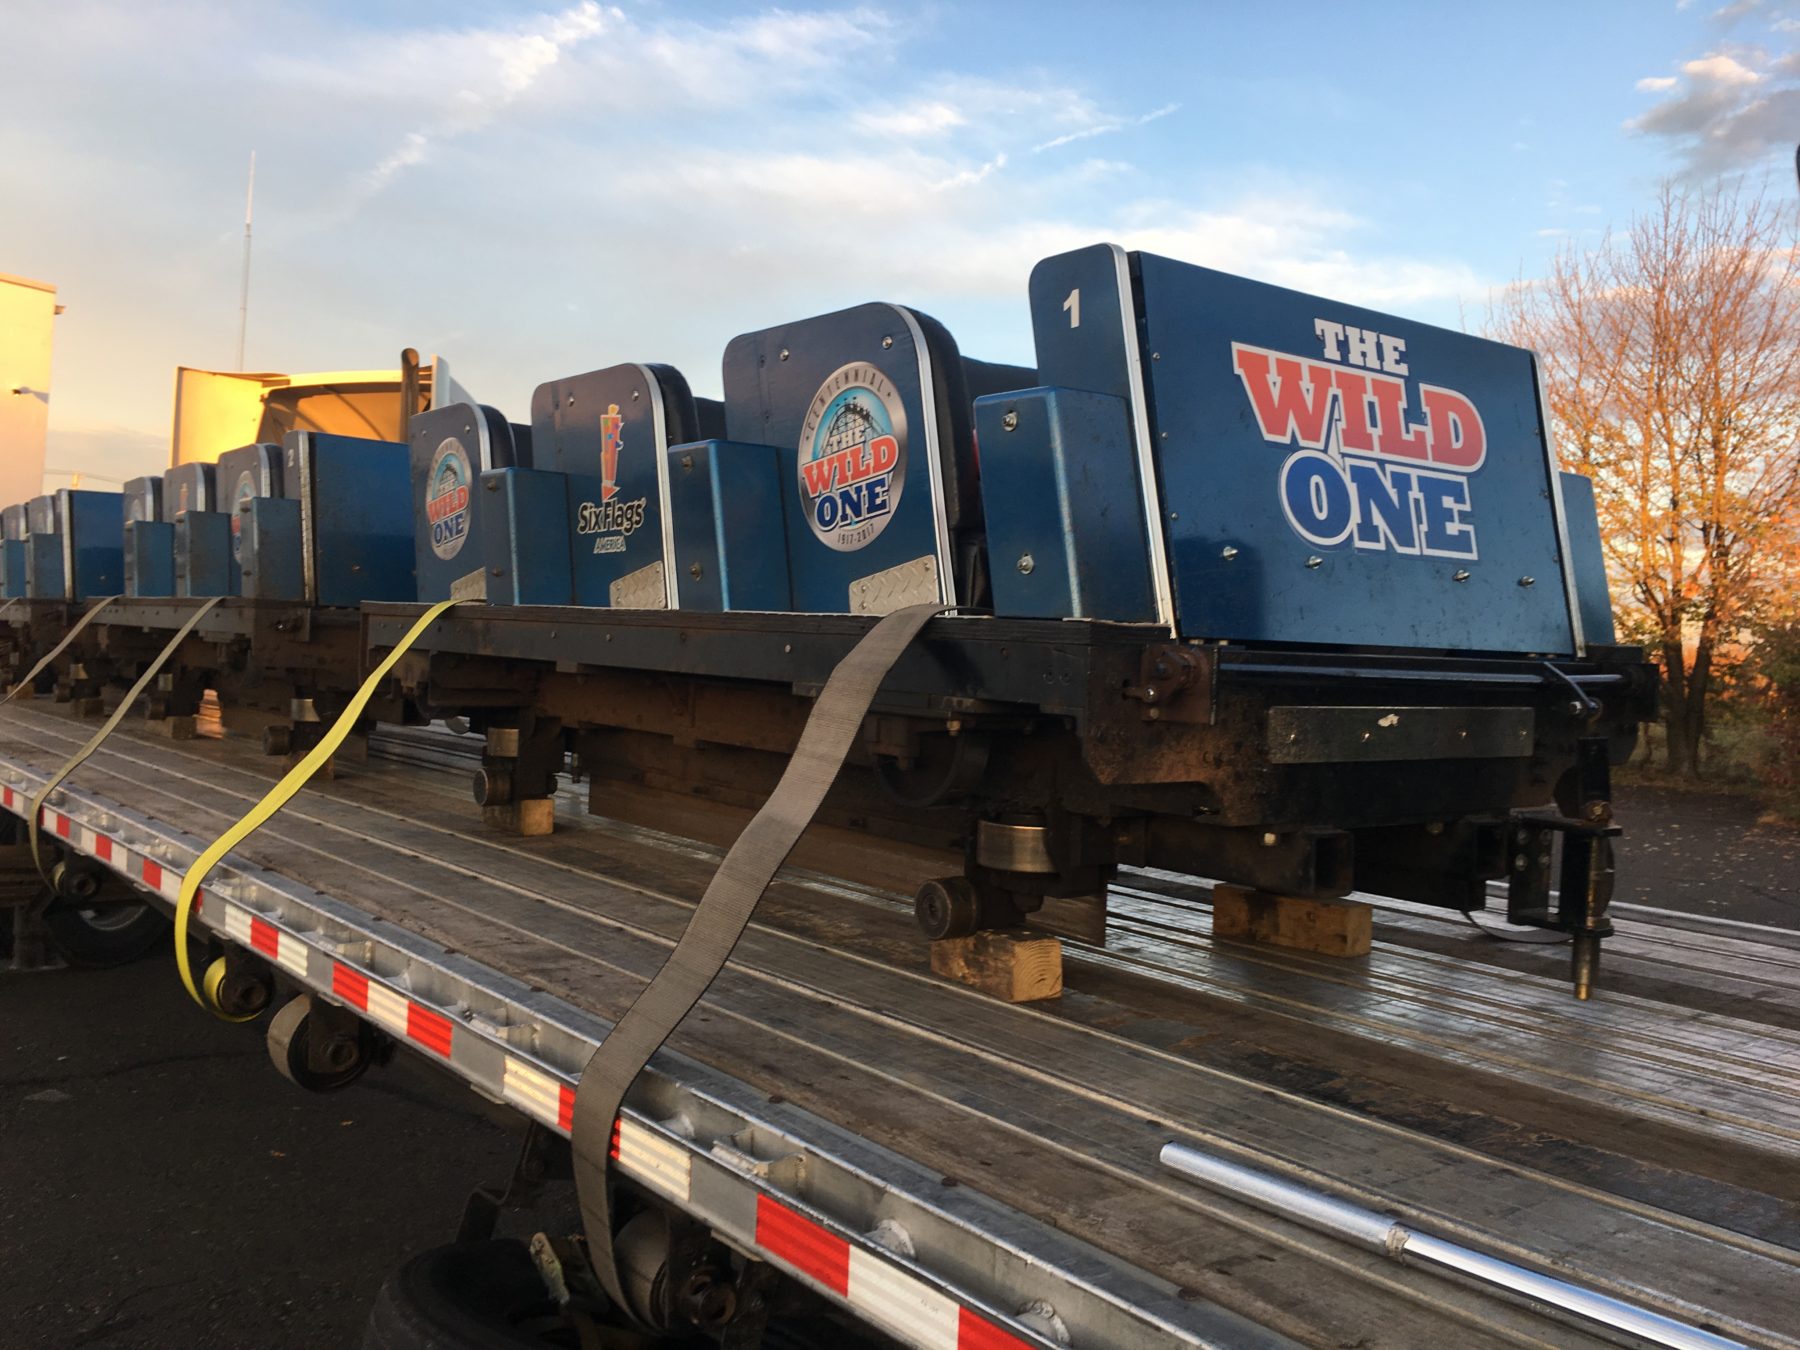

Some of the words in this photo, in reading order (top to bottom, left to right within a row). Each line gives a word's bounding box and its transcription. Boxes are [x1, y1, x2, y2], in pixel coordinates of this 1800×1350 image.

[1063, 288, 1080, 328] 1
[1314, 318, 1409, 377] THE
[807, 368, 884, 430] CENTENNIAL
[1231, 341, 1486, 473] WILD
[830, 426, 865, 450] THE
[803, 435, 898, 498] WILD
[427, 485, 469, 524] WILD
[433, 511, 465, 545] ONE
[815, 475, 890, 531] ONE
[1279, 449, 1478, 560] ONE
[837, 523, 875, 545] 1917-2017
